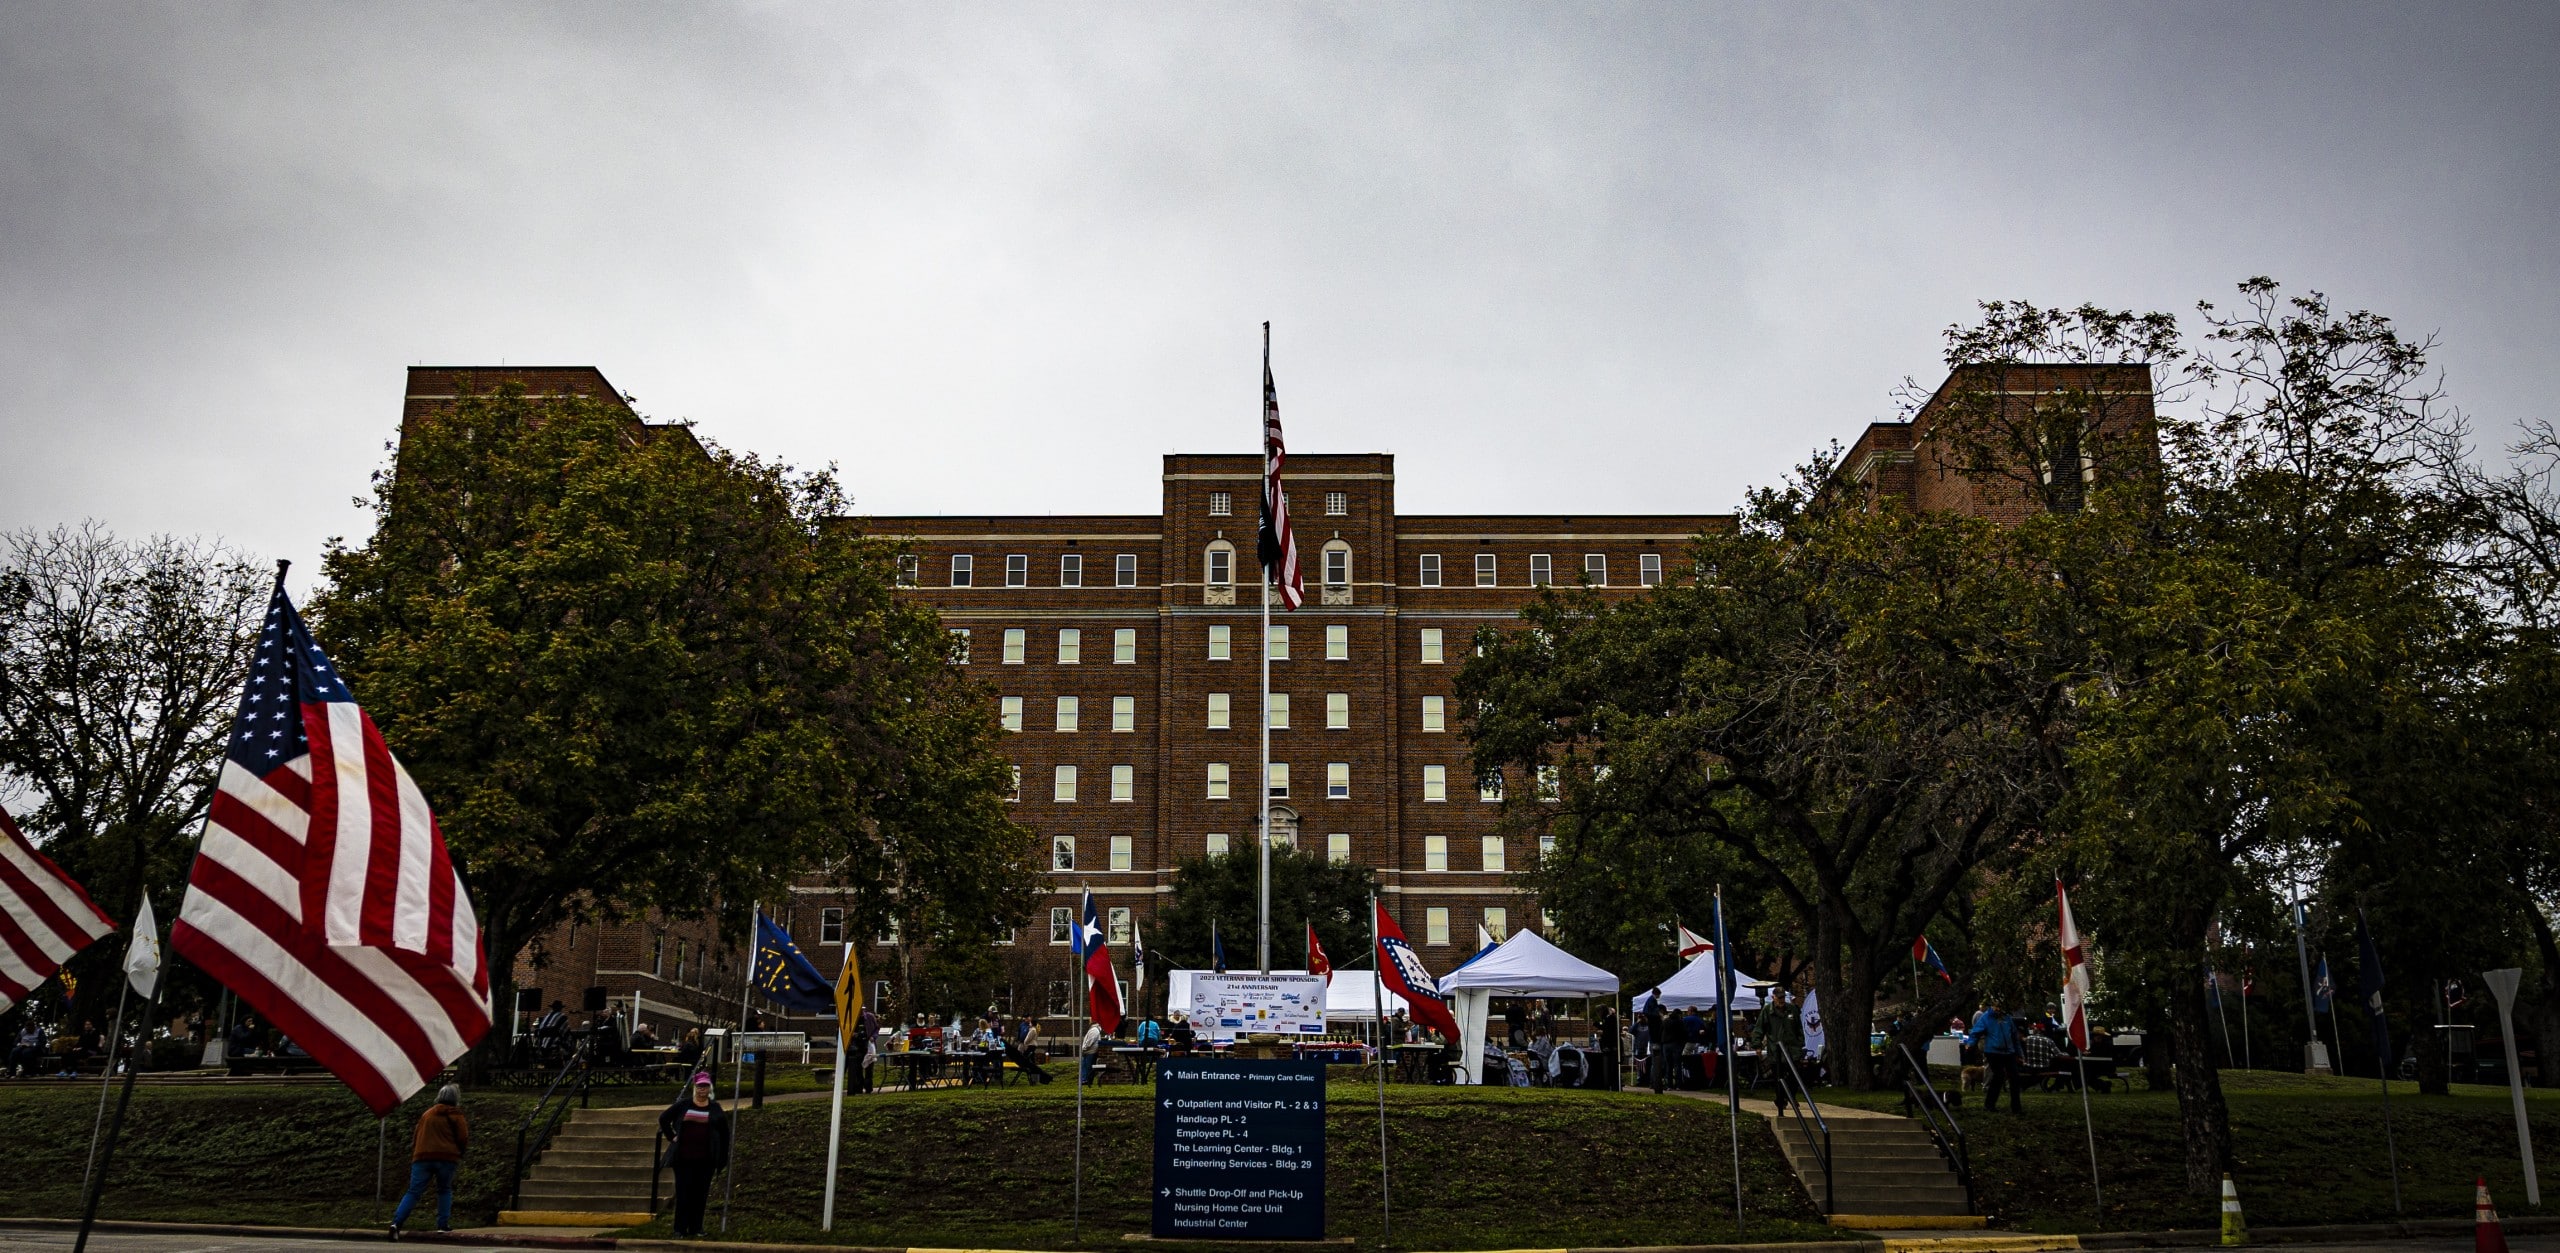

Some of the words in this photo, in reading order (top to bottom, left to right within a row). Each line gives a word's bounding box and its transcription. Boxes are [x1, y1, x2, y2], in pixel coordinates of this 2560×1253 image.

[1406, 955, 1430, 980] ARKANSA
[1178, 1071, 1198, 1080] Main
[1201, 1072, 1240, 1080] Entrance
[1177, 1099, 1223, 1109] Outpatient
[1225, 1100, 1242, 1109] and
[1244, 1101, 1272, 1109] Visitor
[1275, 1101, 1287, 1109] PL
[1303, 1102, 1310, 1110] &
[1176, 1115, 1218, 1125] Handicap
[1220, 1115, 1232, 1124] PL
[1176, 1129, 1220, 1139] Employee
[1174, 1144, 1190, 1152] The
[1193, 1144, 1231, 1154] Learning
[1234, 1145, 1263, 1153] Center
[1272, 1145, 1295, 1155] Bldg.
[1173, 1159, 1226, 1169] Engineering
[1229, 1160, 1267, 1168] Services
[1276, 1160, 1299, 1170] Bldg.
[1175, 1188, 1206, 1197] Shuttle
[1209, 1189, 1246, 1198] Drop-Off
[1269, 1190, 1303, 1200] Pick-Up
[1174, 1203, 1209, 1213] Nursing
[1212, 1204, 1238, 1212] Home
[1241, 1204, 1262, 1213] Care
[1265, 1205, 1283, 1213] Unit
[1174, 1219, 1216, 1227] Industrial
[1218, 1219, 1248, 1228] Center
